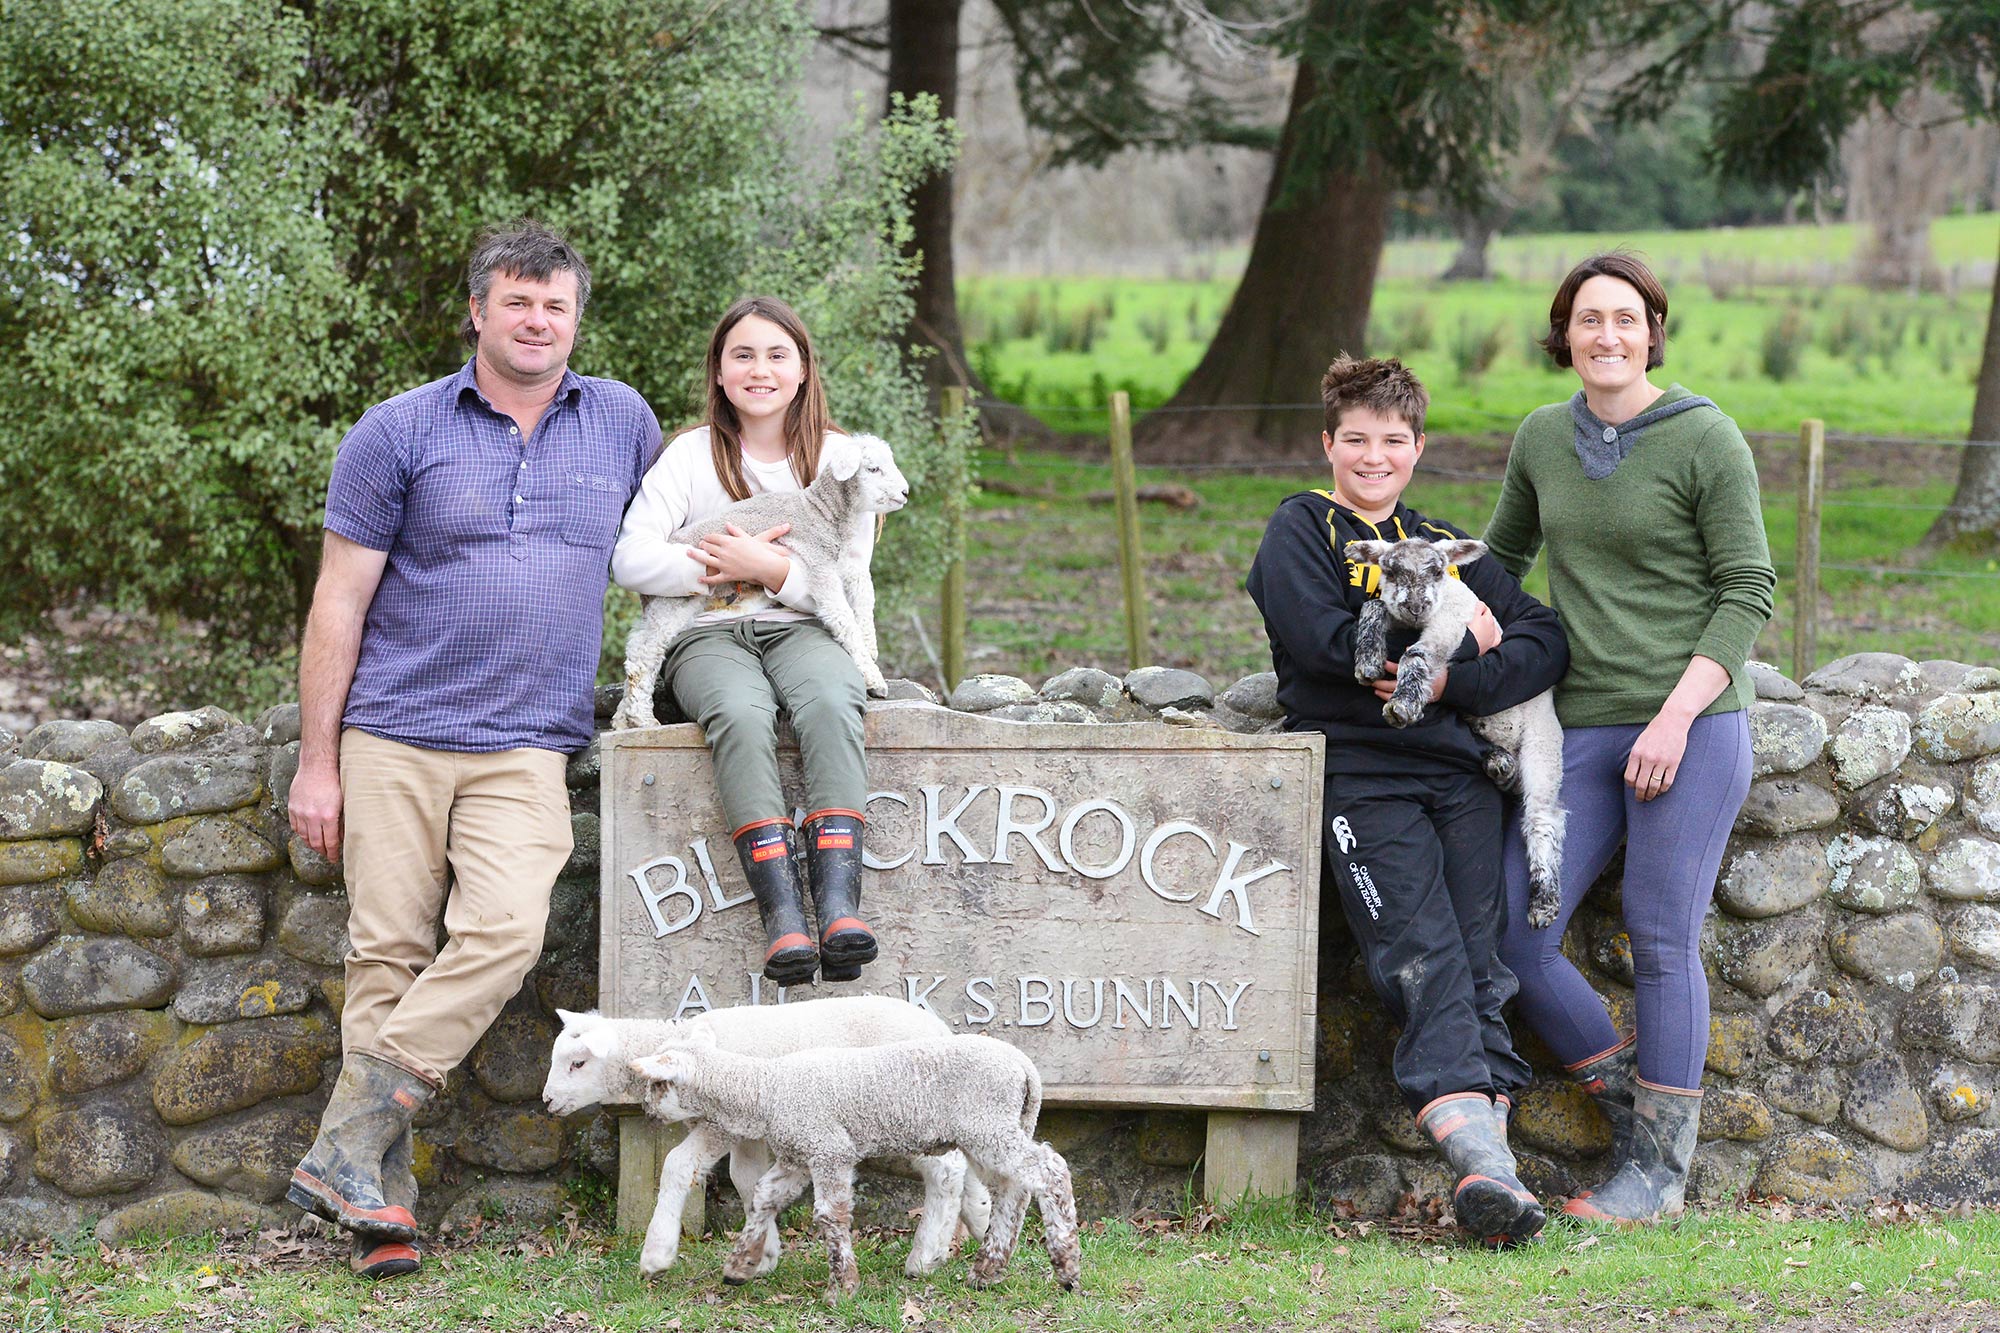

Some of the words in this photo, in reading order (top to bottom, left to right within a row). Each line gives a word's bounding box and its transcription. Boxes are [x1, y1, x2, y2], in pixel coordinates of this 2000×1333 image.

[627, 786, 1290, 938] BLCKROCK
[1349, 862, 1359, 873] OF
[1353, 873, 1365, 889] NEW
[1360, 866, 1383, 907] CANTERBURY
[1361, 889, 1379, 920] ZEALAND
